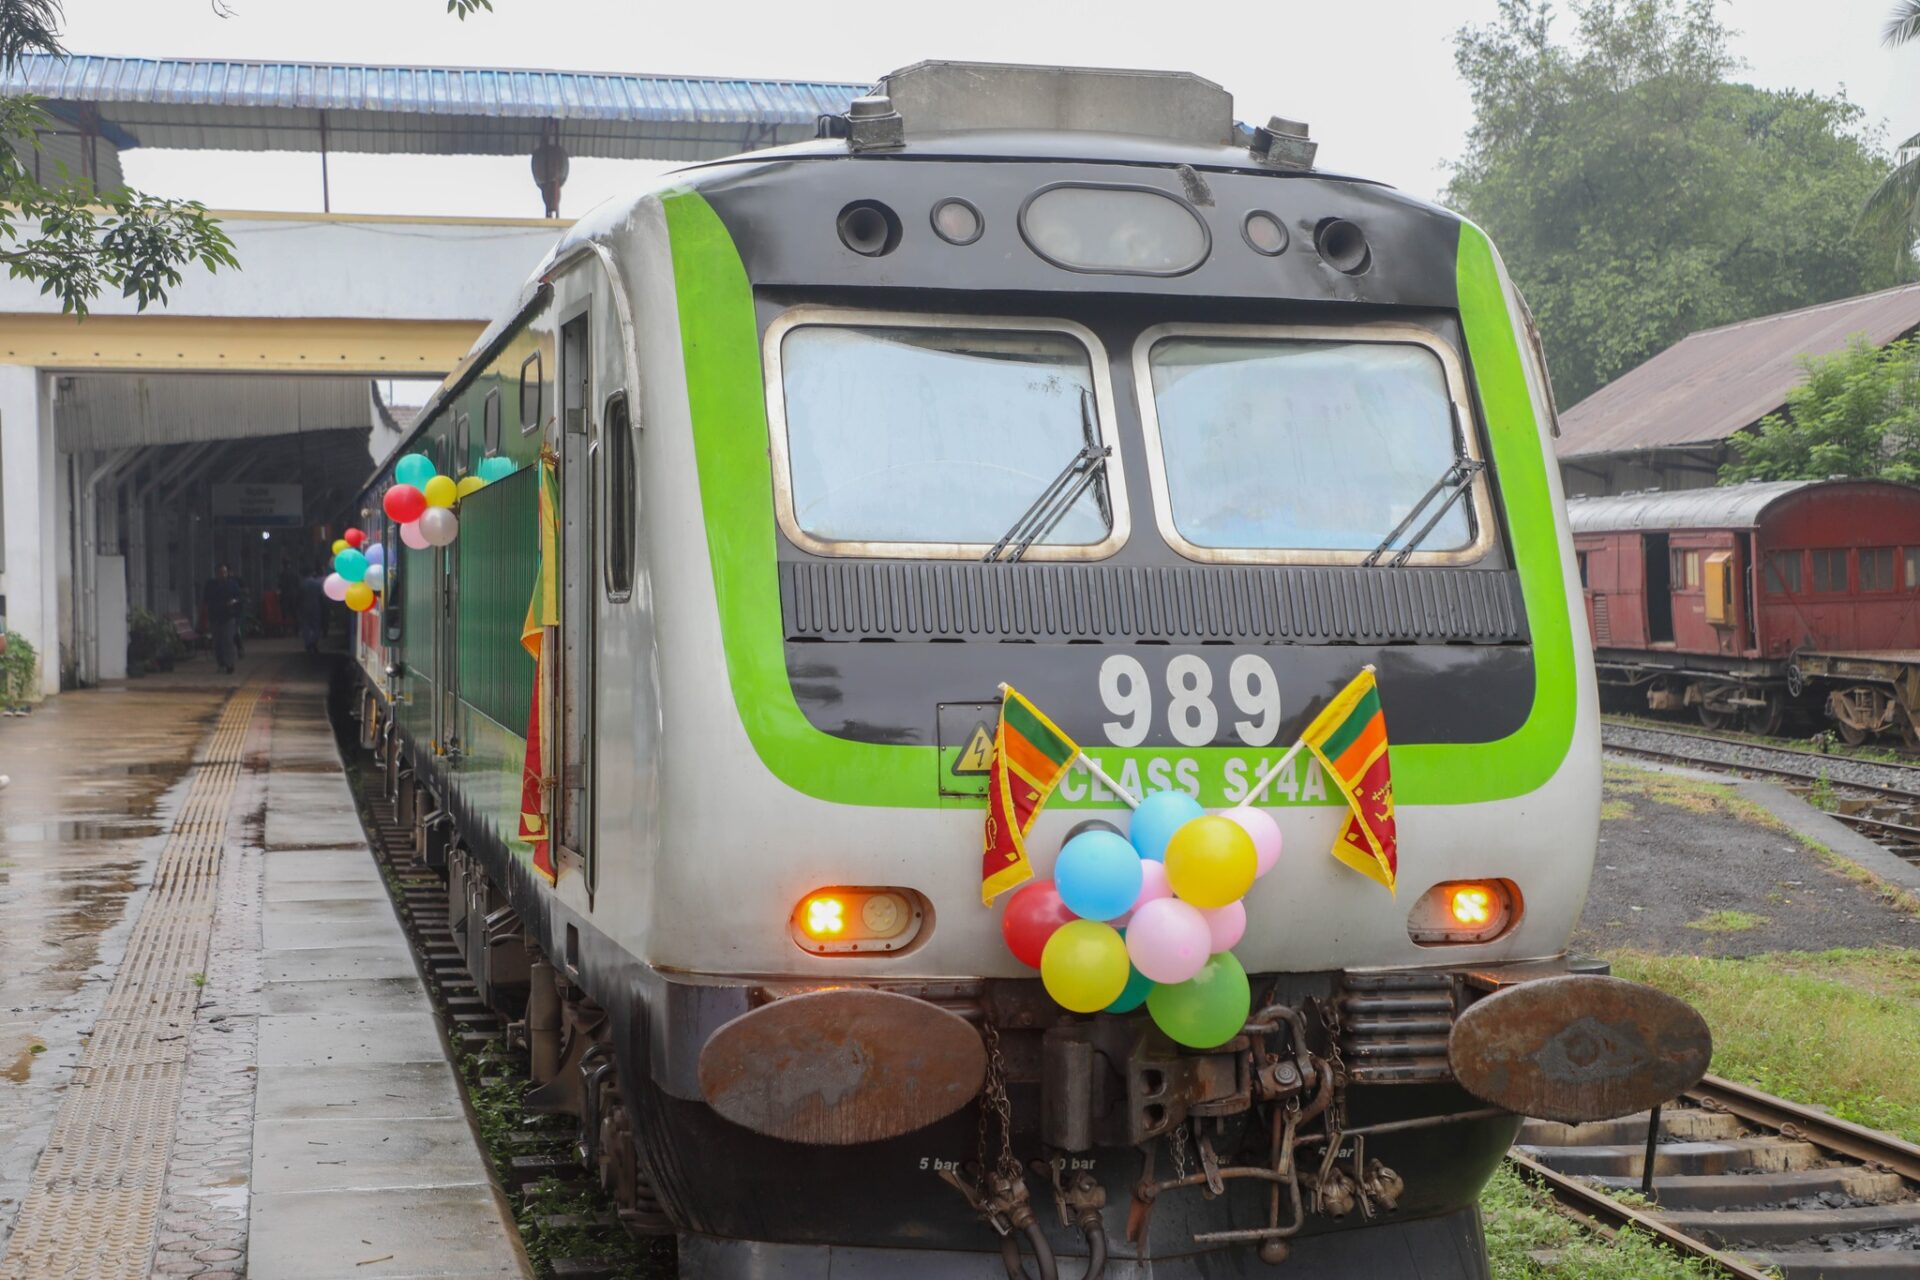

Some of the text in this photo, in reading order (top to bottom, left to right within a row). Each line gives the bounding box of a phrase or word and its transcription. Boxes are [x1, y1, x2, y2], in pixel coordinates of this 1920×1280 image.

[1098, 653, 1281, 748] 989
[1059, 757, 1327, 802] CLASS S14A
[919, 1157, 960, 1170] 5 bar
[1071, 1158, 1096, 1170] bar
